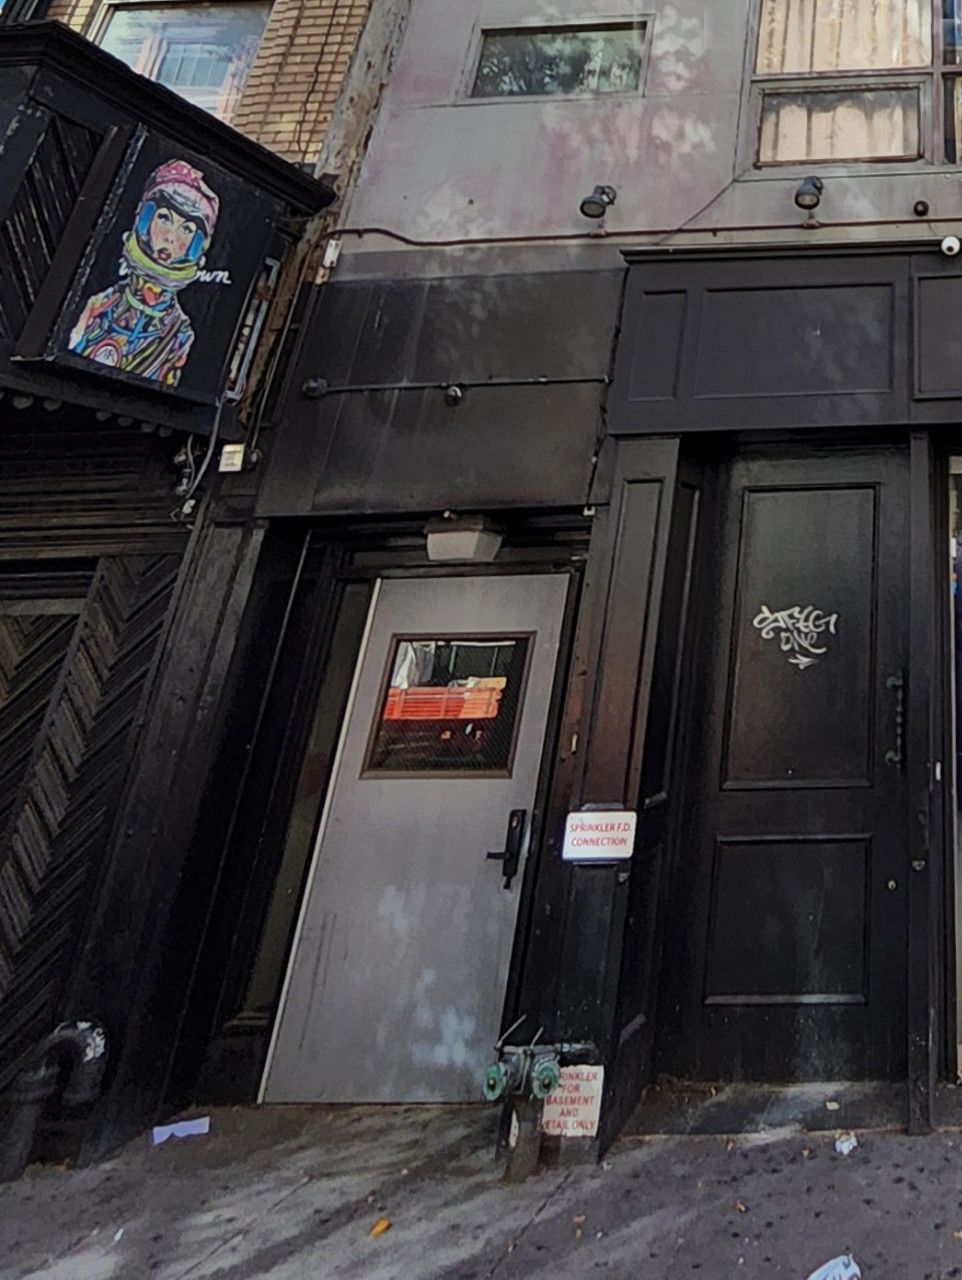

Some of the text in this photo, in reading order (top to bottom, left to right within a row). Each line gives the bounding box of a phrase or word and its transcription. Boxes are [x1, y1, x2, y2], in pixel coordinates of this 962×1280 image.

[569, 822, 632, 833] SPRINKLER F.D.
[571, 837, 627, 847] CONNECTION
[559, 1071, 598, 1081] RINKLER
[546, 1095, 594, 1106] BASEMENT
[559, 1107, 579, 1118] AND
[543, 1120, 594, 1131] ETAIL ONLY
